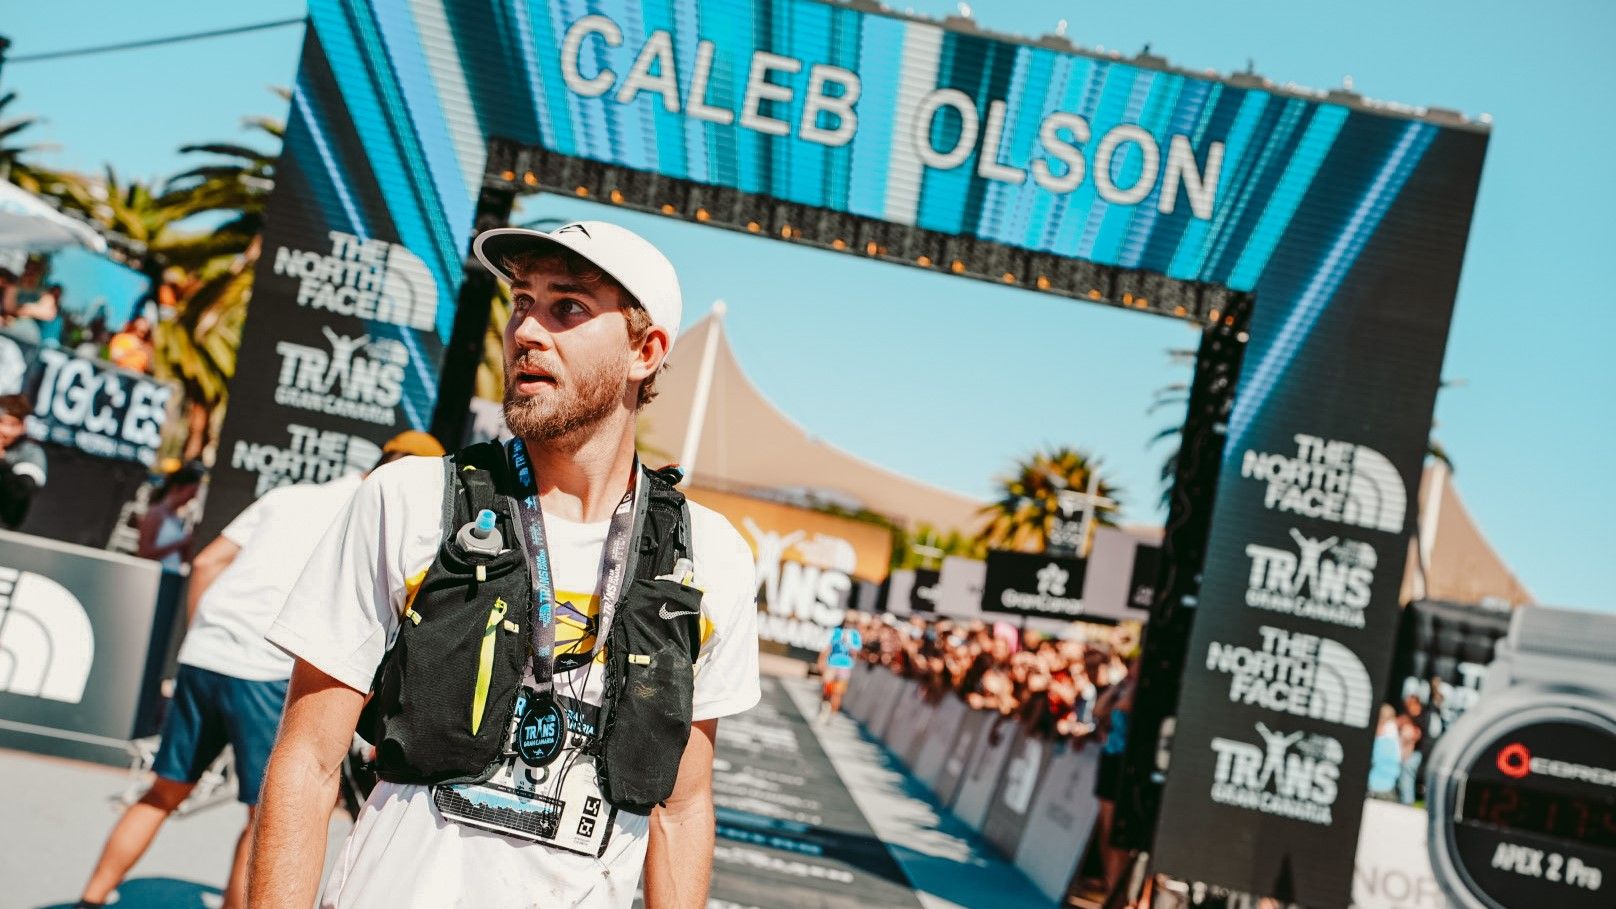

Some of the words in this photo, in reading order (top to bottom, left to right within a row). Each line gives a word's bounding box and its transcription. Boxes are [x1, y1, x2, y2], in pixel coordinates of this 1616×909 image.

[561, 14, 862, 148] CALEB
[914, 88, 1225, 220] OLSON
[329, 230, 389, 262] THE
[274, 247, 383, 292] NORTH
[297, 276, 377, 320] FACE
[276, 331, 406, 408] TRANS
[231, 439, 344, 485] NORTH
[287, 424, 349, 459] THE
[1294, 433, 1355, 465] THE
[1241, 449, 1348, 494] NORTH
[1264, 480, 1342, 522] FACE
[1245, 534, 1374, 610] TRANS
[1206, 641, 1315, 687] NORTH
[1259, 625, 1320, 660] THE
[1229, 671, 1312, 716] FACE
[524, 718, 555, 740] TRANS
[1210, 727, 1341, 806] TRANS
[1491, 842, 1544, 878] APEX
[1546, 853, 1564, 883] 2
[1566, 856, 1602, 891] Pro
